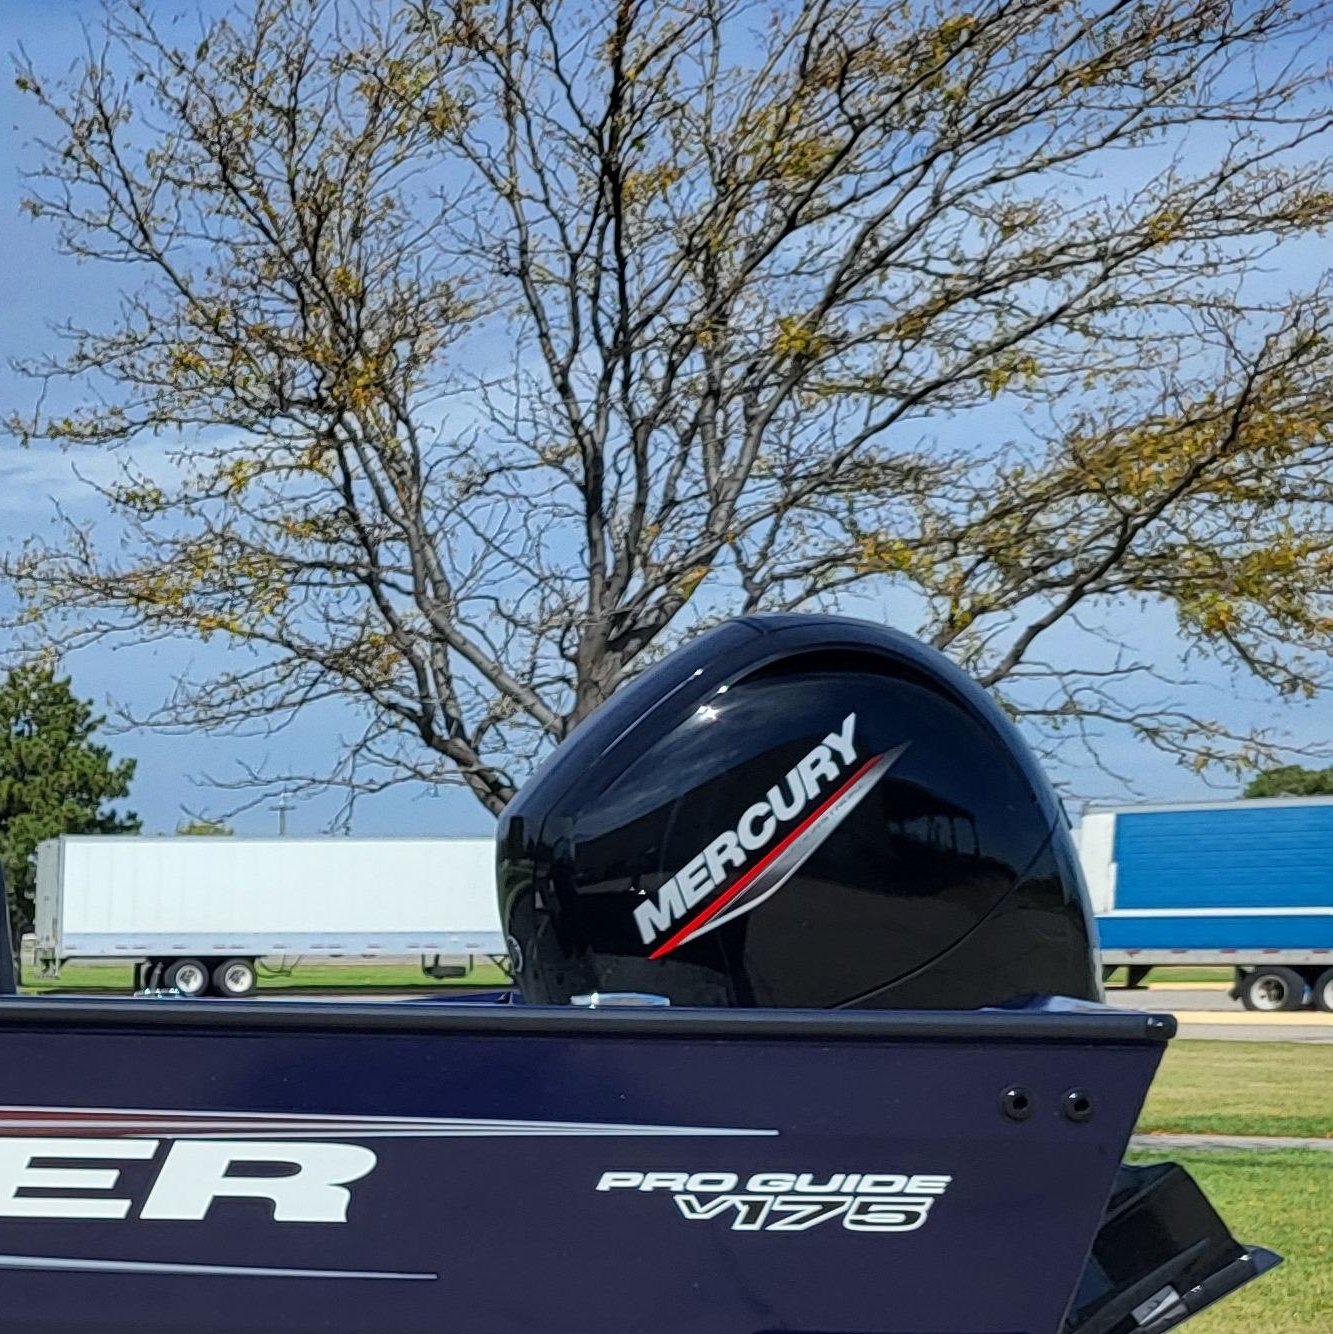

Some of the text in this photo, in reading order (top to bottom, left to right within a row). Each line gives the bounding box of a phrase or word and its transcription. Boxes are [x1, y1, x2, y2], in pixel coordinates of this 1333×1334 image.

[633, 711, 857, 945] MERCURY
[595, 1171, 953, 1194] PRO GUIDE
[673, 1194, 935, 1232] V175
